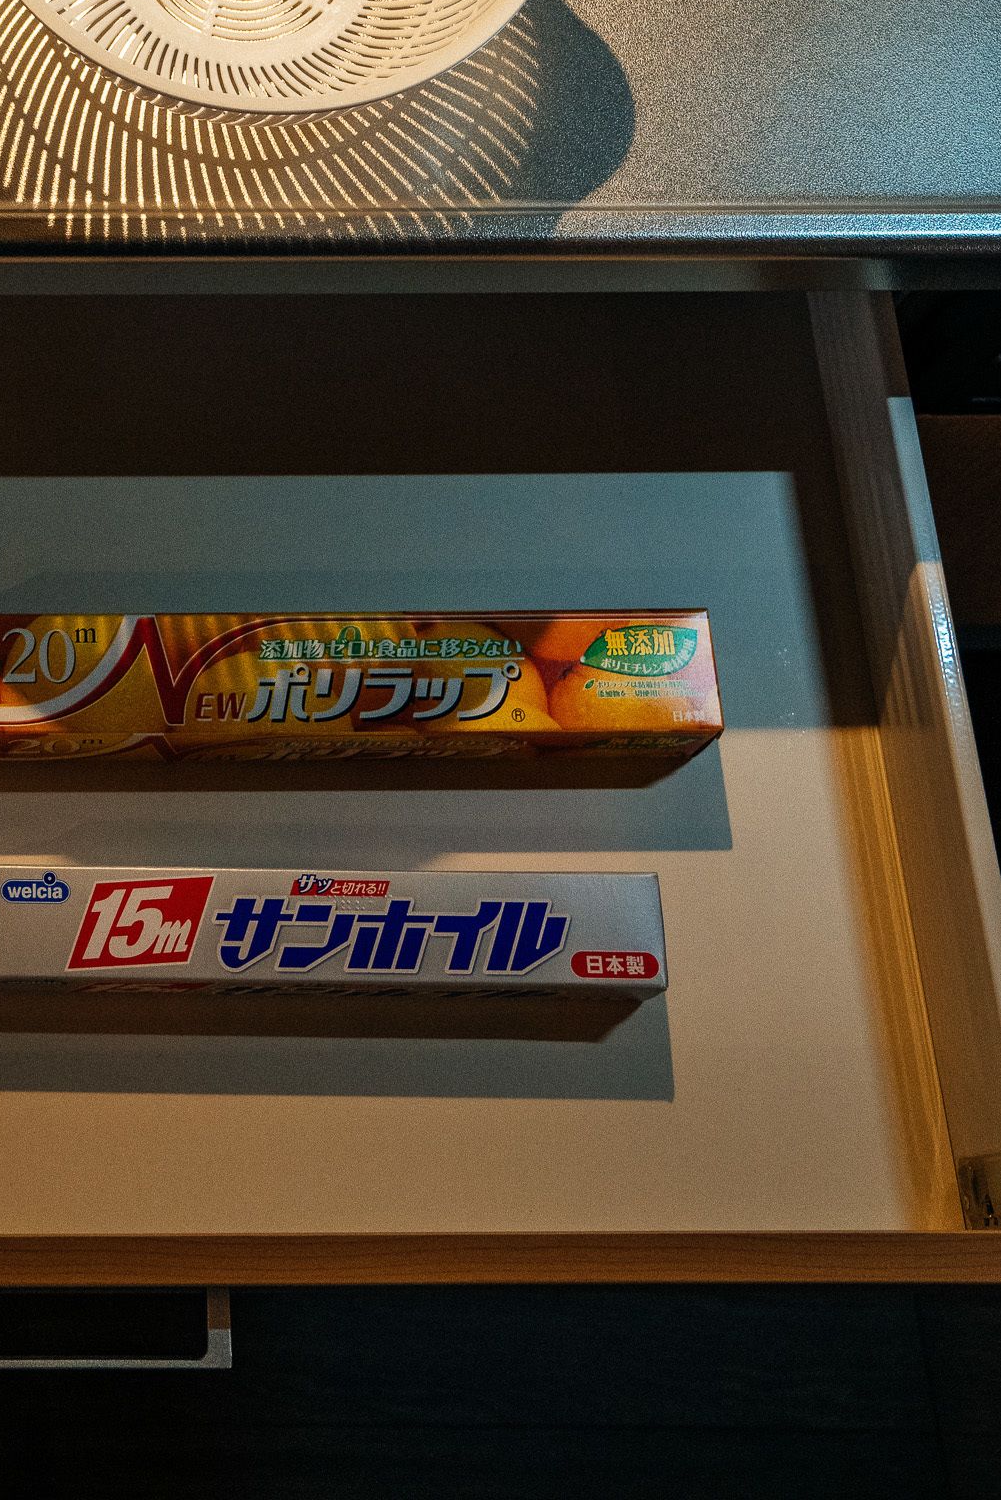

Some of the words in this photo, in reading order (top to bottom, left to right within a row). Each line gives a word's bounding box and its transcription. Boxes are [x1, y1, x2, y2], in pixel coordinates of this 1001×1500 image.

[604, 628, 677, 656] 無添加
[246, 661, 522, 723] ポリラップ
[6, 880, 64, 900] welcia
[81, 884, 193, 959] 15m
[213, 896, 571, 974] サンホイル
[585, 954, 645, 975] 日本製
